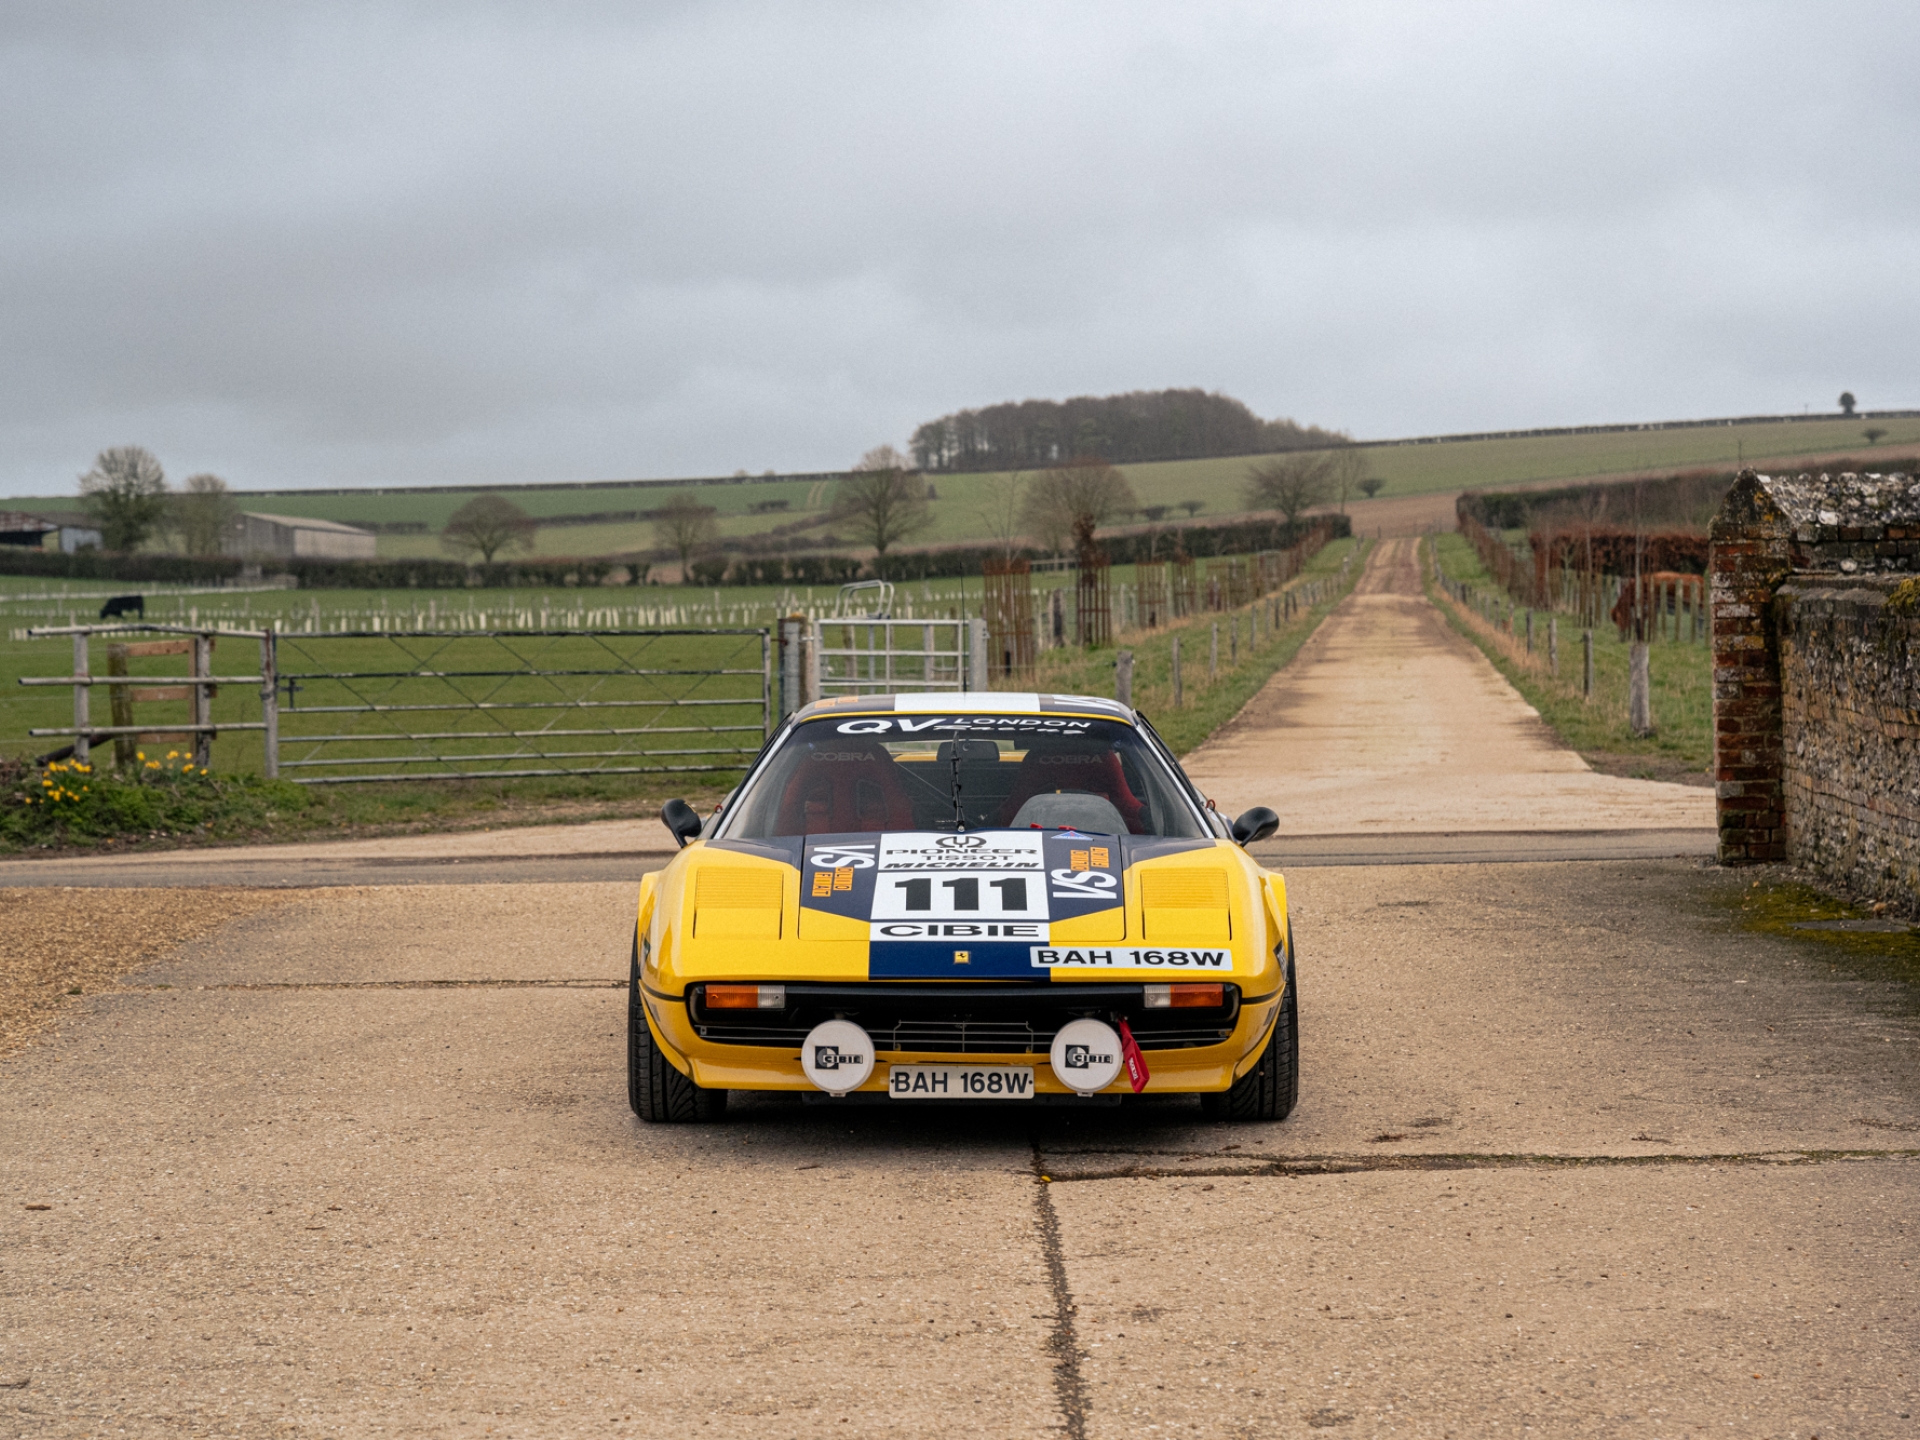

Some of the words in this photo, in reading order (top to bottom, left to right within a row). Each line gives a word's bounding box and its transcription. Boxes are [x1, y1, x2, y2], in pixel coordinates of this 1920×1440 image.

[837, 718, 947, 734] QV
[953, 718, 1092, 728] LONDON
[811, 751, 876, 762] COBRA
[1039, 754, 1103, 765] COBRA
[810, 844, 876, 869] VS
[1052, 868, 1117, 899] VS
[894, 877, 1028, 911] 111
[880, 925, 1039, 937] CIBIE
[1037, 950, 1113, 965] BAH
[1129, 951, 1225, 967] 168W
[894, 1071, 948, 1093] BAH
[960, 1072, 1029, 1094] 168W
